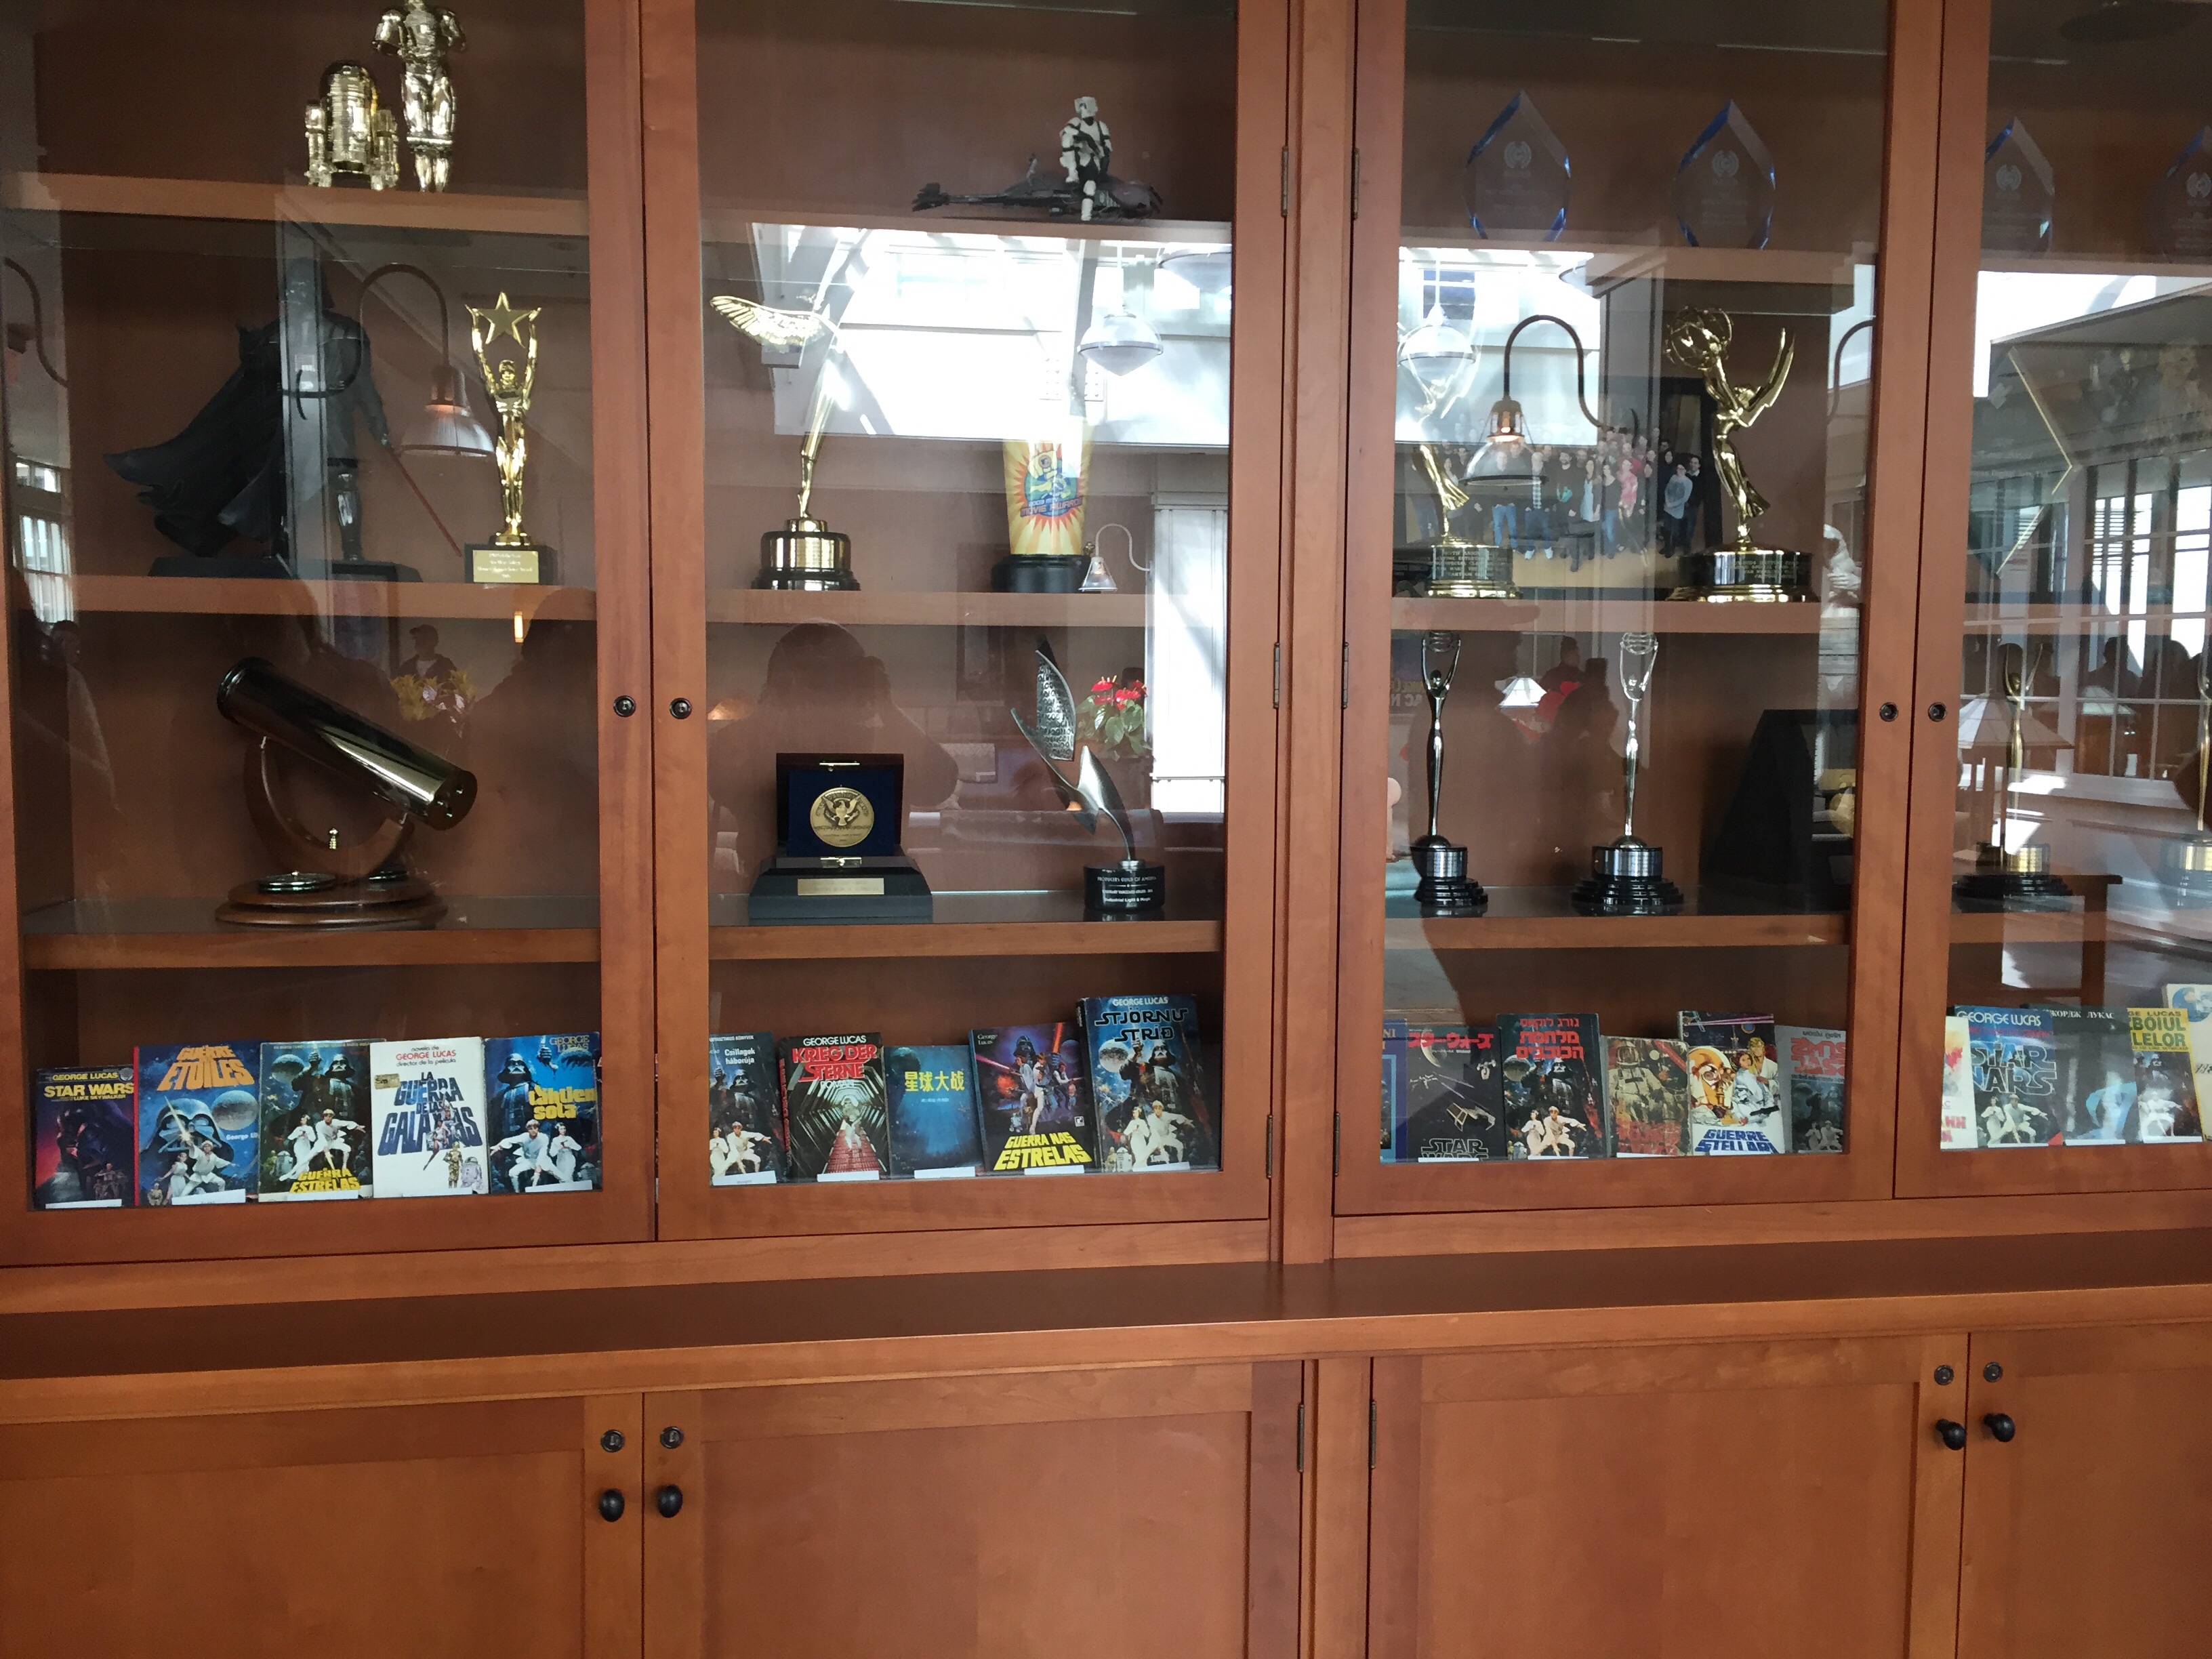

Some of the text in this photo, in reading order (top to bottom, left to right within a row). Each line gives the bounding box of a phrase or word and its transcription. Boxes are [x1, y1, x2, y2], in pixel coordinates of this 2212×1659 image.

[1112, 996, 1169, 1006] GEORGE LUCAS
[1957, 1010, 2041, 1026] GEORGE LUCAS
[2043, 1009, 2082, 1019] ЖОРДЖ
[2129, 1017, 2186, 1031] BOIUL
[549, 1034, 590, 1045] GEORGE
[557, 1042, 589, 1052] LUCAS
[803, 1035, 867, 1046] GEORGE LUCAS
[396, 1050, 456, 1061] GEORGE LUCAS
[792, 1044, 878, 1063] KRIEG DER
[1971, 1042, 2057, 1070] STAR
[421, 1071, 434, 1081] LA
[798, 1059, 872, 1082] STERNE
[905, 1071, 965, 1092] 星球大战
[1973, 1066, 2057, 1096] WARS
[44, 1082, 134, 1097] STAR WARS
[394, 1078, 465, 1106] GUERRA
[415, 1101, 443, 1114] DE LAS
[377, 1106, 483, 1156] GALAXAS
[1704, 1129, 1770, 1141] GUERRE
[1004, 1132, 1077, 1149] GUERRA NAS
[1420, 1138, 1489, 1153] STAR
[994, 1144, 1092, 1170] ESTRELAS
[298, 1168, 352, 1181] GUERRA
[289, 1176, 361, 1193] ESTRELAS
